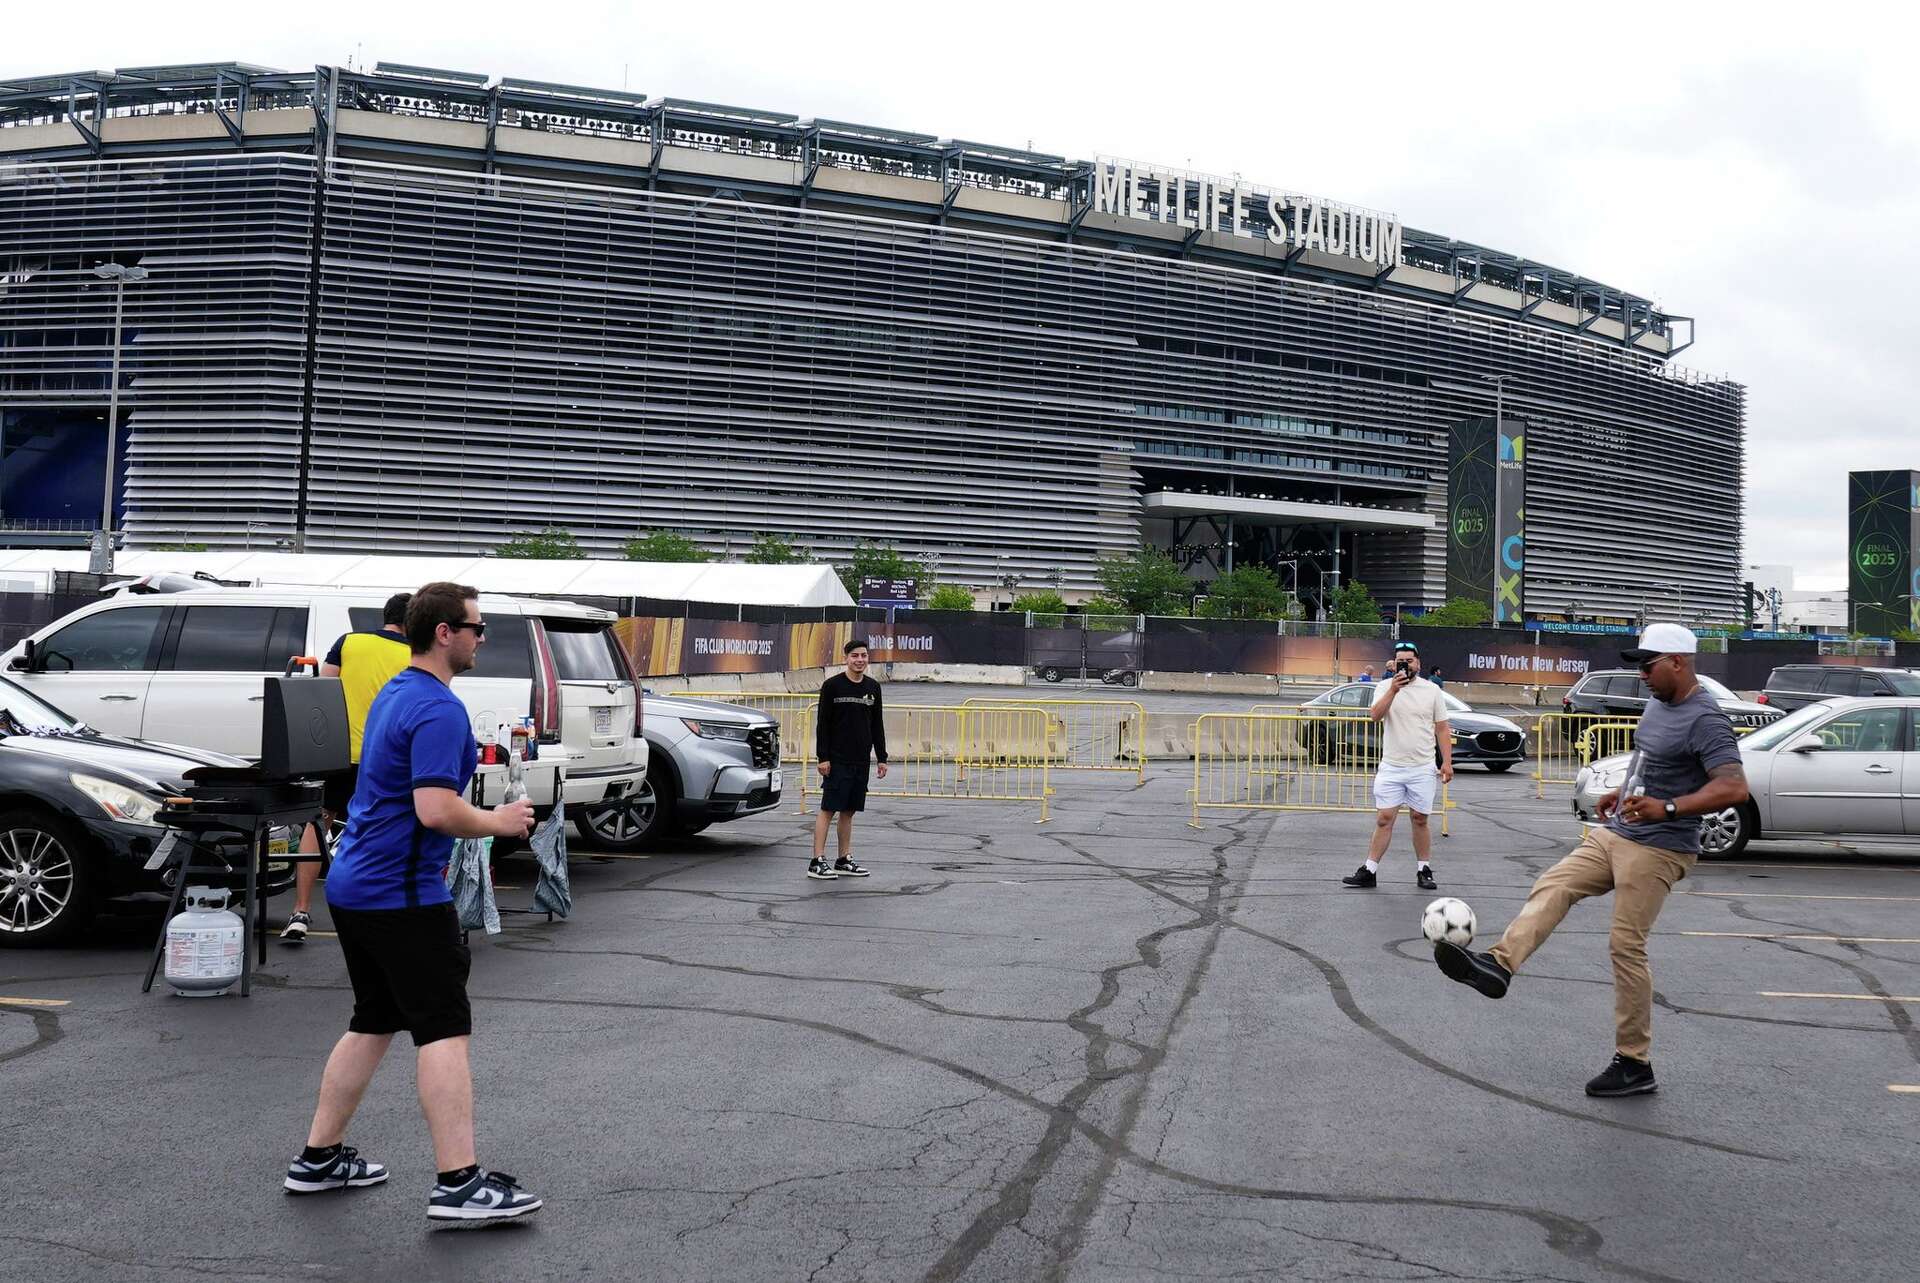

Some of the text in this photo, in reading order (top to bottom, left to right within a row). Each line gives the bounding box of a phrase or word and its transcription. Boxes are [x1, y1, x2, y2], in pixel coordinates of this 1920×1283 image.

[1095, 156, 1401, 267] METLIFE STADIUM
[1500, 461, 1522, 469] MetLife
[1459, 519, 1483, 533] 2025
[1863, 554, 1895, 566] 2025
[1543, 623, 1570, 631] WELCOME
[1572, 623, 1580, 631] TO
[695, 638, 708, 654] FIFA
[709, 638, 724, 654] CLUB
[725, 639, 746, 655] WORLD
[747, 640, 757, 655] CUP
[897, 635, 933, 650] World
[1469, 653, 1589, 673] New York New Jersey
